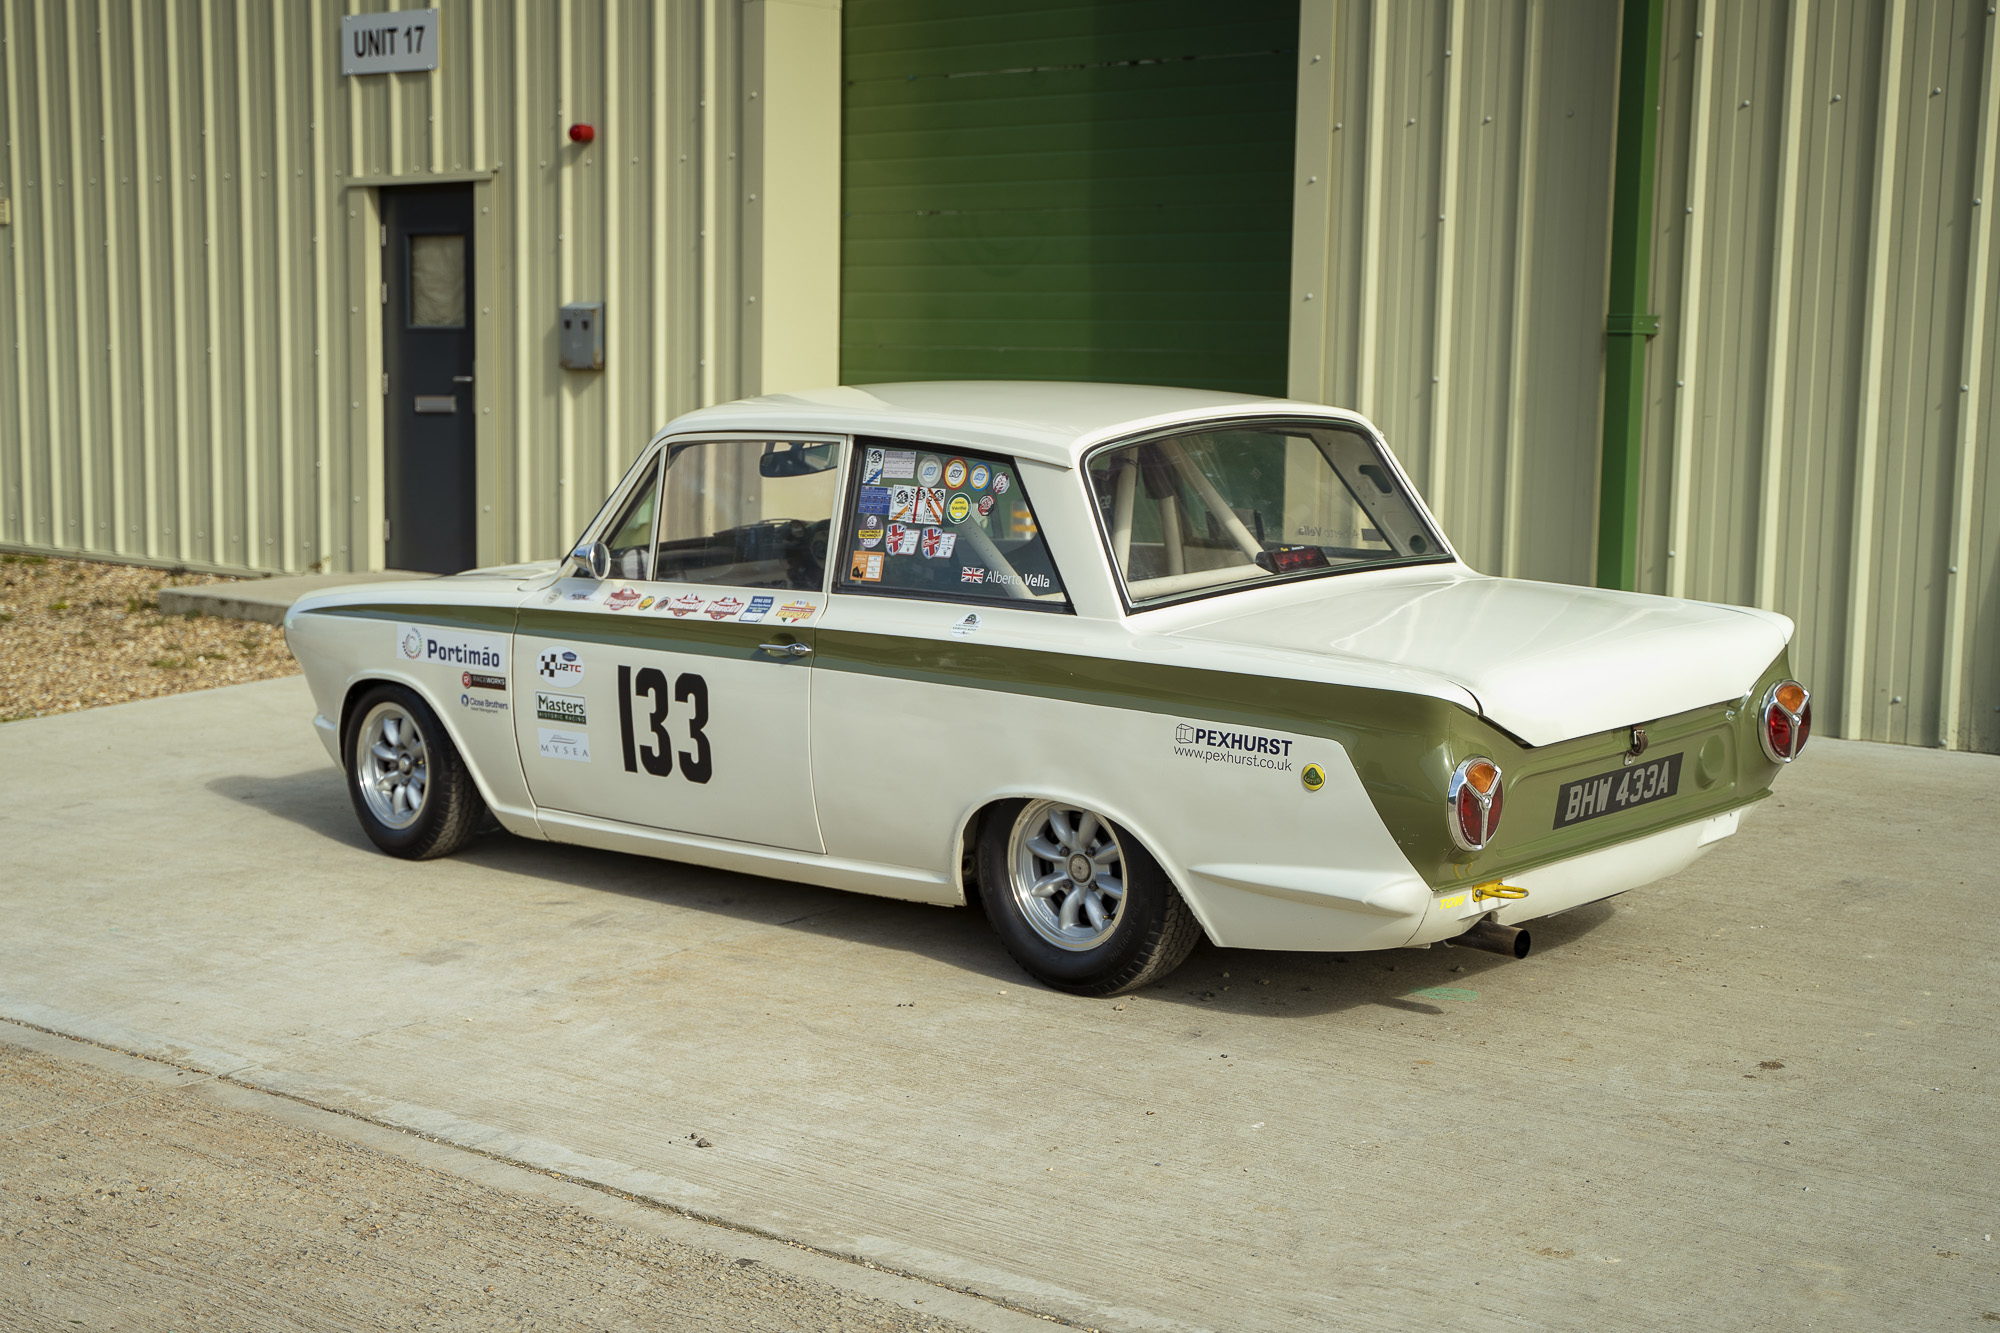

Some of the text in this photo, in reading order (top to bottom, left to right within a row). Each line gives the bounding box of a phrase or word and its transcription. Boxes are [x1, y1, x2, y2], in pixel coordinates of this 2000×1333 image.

[353, 25, 425, 58] UNIT 17
[985, 570, 1050, 588] Alberto Vella
[427, 639, 500, 667] Portimão
[555, 662, 582, 673] U2TC
[485, 699, 508, 710] Brothers
[538, 694, 585, 715] Masters
[617, 664, 713, 785] 133
[1195, 728, 1293, 757] PEXHURST
[1174, 746, 1292, 772] www.pexhurst.co.uk
[1565, 761, 1670, 822] BHW 433A
[1439, 894, 1466, 911] TOW
